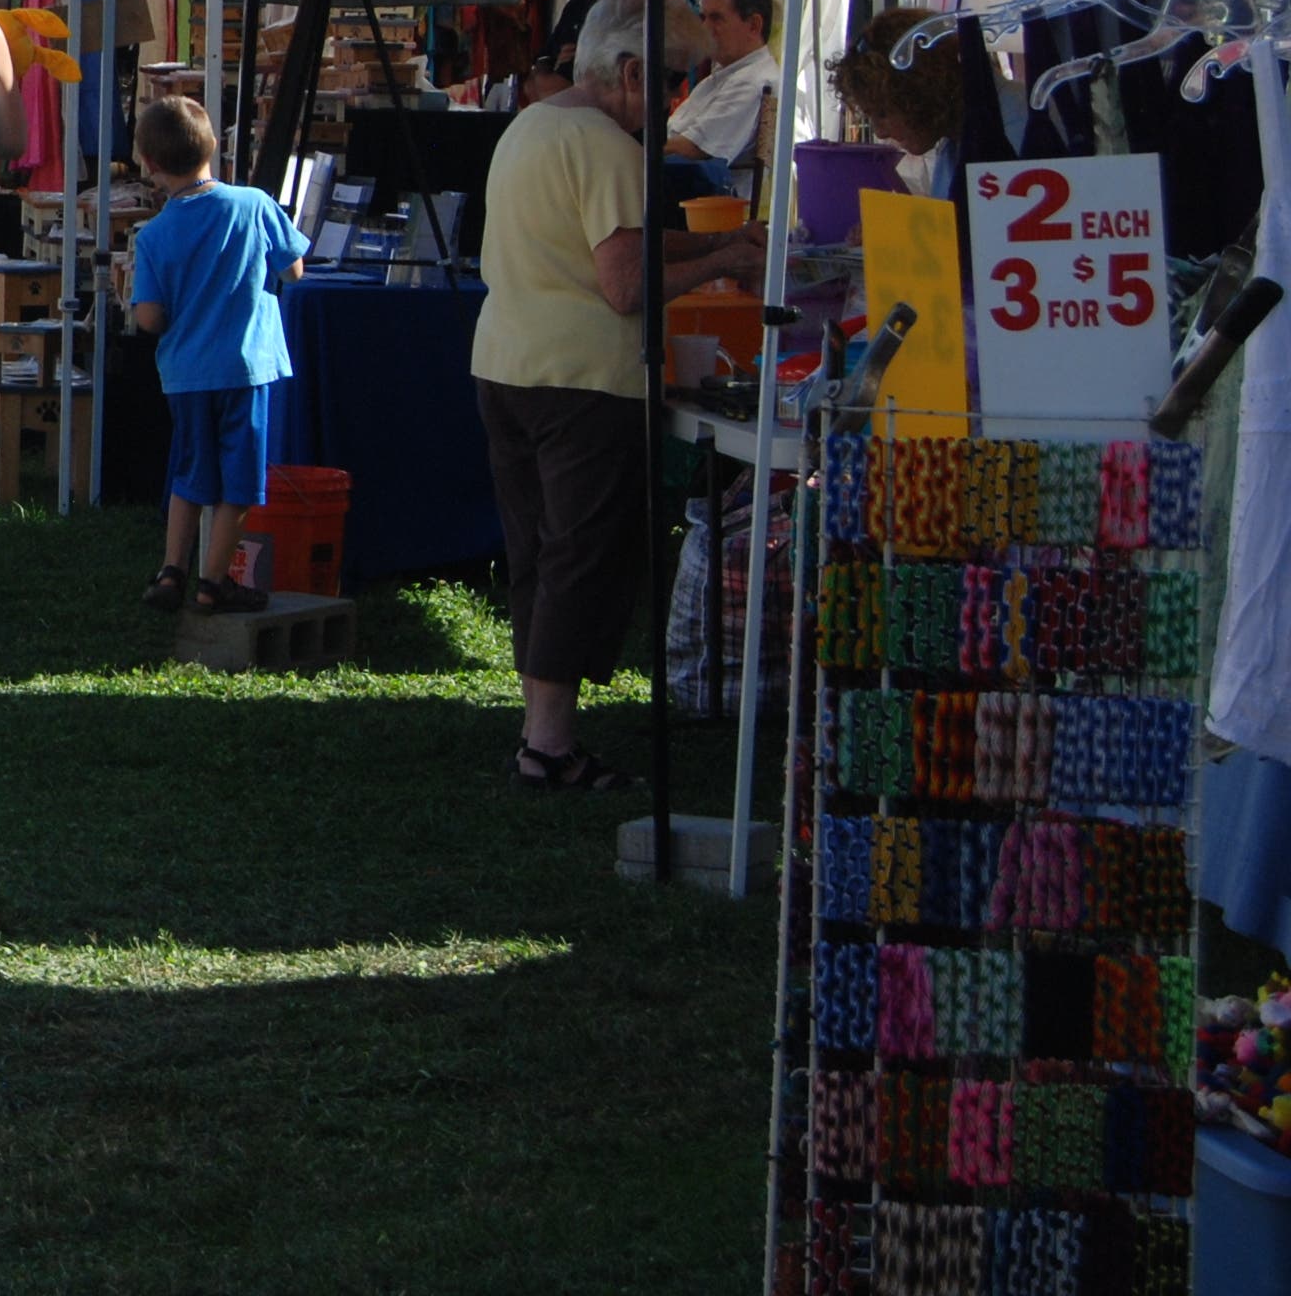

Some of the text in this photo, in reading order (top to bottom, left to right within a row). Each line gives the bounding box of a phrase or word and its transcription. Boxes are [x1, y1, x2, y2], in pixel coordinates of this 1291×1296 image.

[1081, 209, 1150, 240] EACH
[990, 256, 1041, 332] 3
[1048, 299, 1100, 329] FOR
